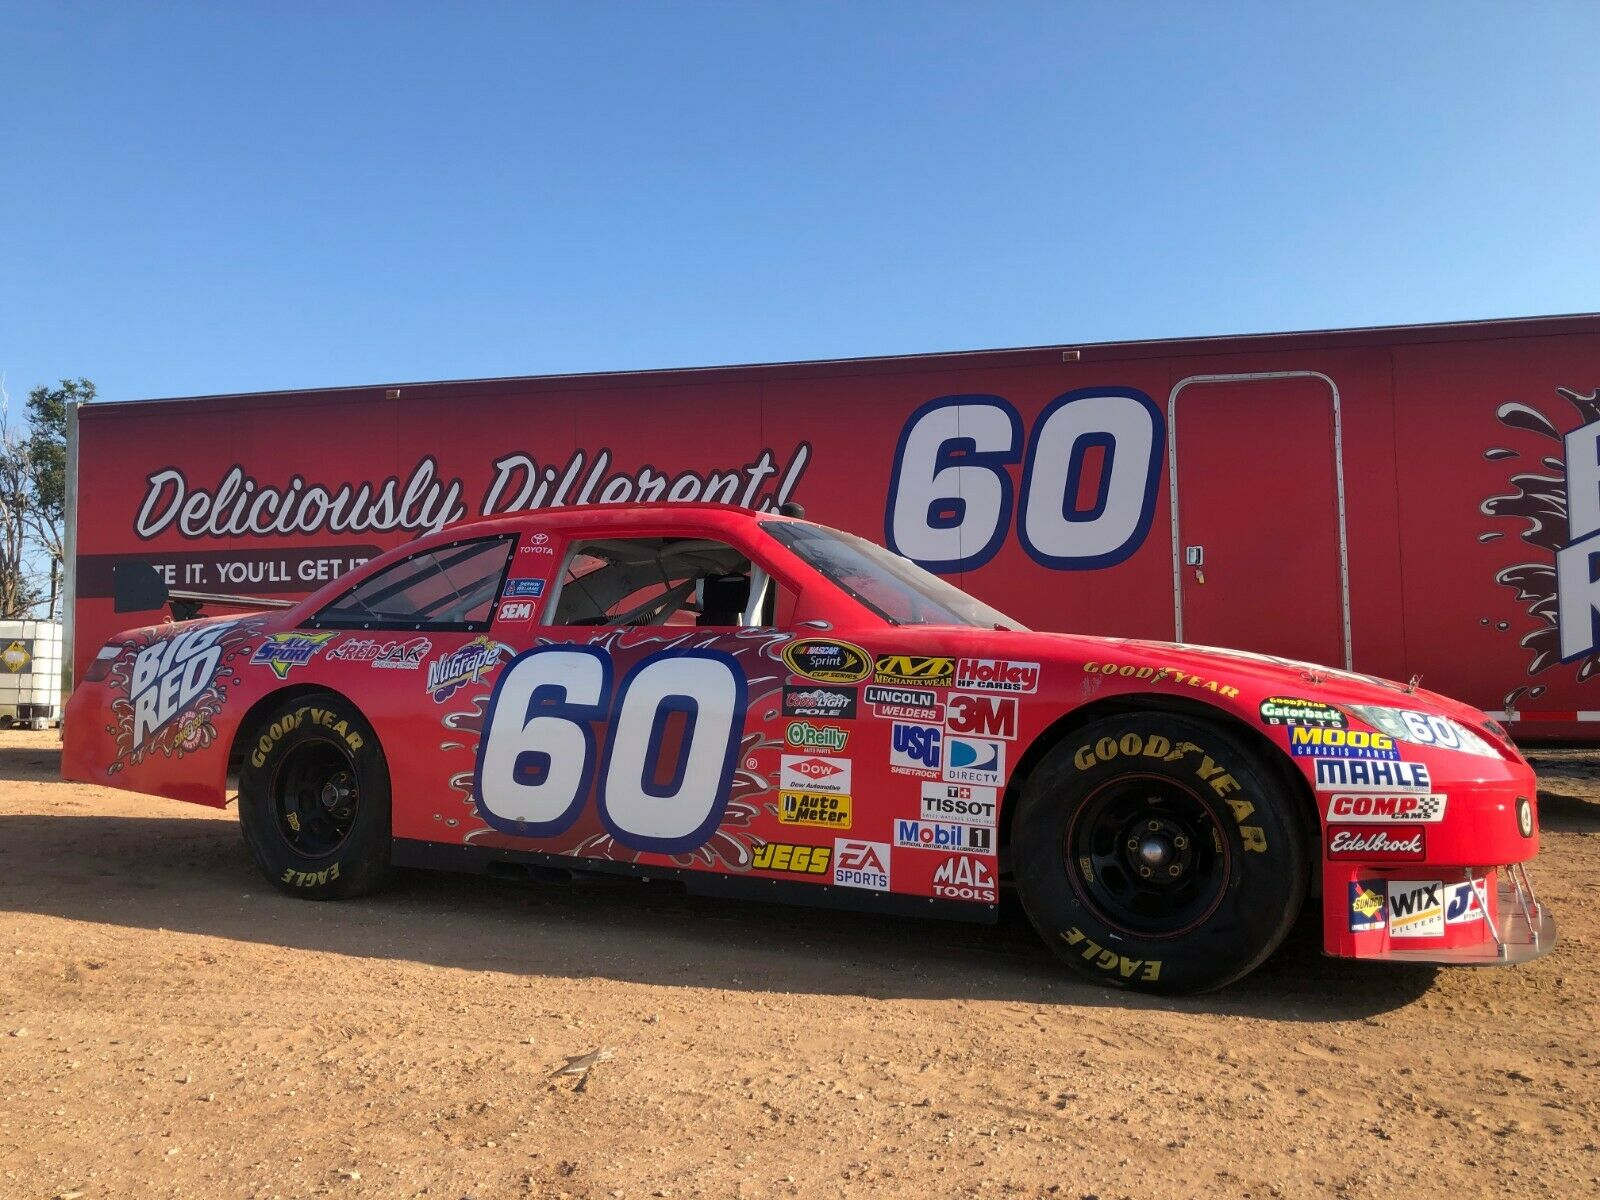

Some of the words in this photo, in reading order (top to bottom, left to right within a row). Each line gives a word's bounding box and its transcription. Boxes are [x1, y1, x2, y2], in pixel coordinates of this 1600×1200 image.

[887, 389, 1162, 570] 60
[136, 456, 465, 537] Deliciously
[520, 546, 554, 555] TOYOTA
[185, 564, 207, 584] IT.
[216, 561, 291, 583] YOU'LL
[298, 559, 343, 581] GET
[500, 604, 531, 619] SEM
[253, 643, 319, 662] SPORT
[806, 646, 840, 655] NASCAR
[130, 621, 240, 701] BIG
[810, 656, 841, 667] Sprint
[874, 674, 922, 686] MECHANIX
[924, 677, 952, 687] WEAR
[958, 659, 1037, 691] Holley
[958, 680, 975, 689] HP
[977, 680, 1021, 691] CARBS
[133, 645, 222, 749] RED
[786, 692, 817, 707] Coors
[817, 698, 851, 707] LIGHT
[869, 689, 931, 706] LINCOLN
[795, 708, 841, 716] POLE
[881, 706, 936, 719] WELDERS
[947, 695, 1016, 737] 3M
[1261, 703, 1341, 720] Gatorback
[1269, 718, 1342, 728] BELTS
[1400, 711, 1460, 748] 60
[251, 706, 365, 768] GOODYEAR
[788, 723, 846, 749] O'Reilly
[1292, 727, 1393, 750] MOOG
[475, 645, 746, 851] 60
[893, 724, 940, 768] USG
[1297, 746, 1349, 757] CHASSIS
[1359, 748, 1394, 759] PARTS
[890, 766, 938, 779] SHEETROCK
[950, 770, 998, 783] DIRECTV
[1316, 760, 1429, 787] MAHLE
[806, 783, 840, 791] Automotive
[1073, 732, 1267, 853] GOODYEAR
[800, 795, 838, 809] Auto
[923, 798, 995, 816] TISSOT
[1333, 798, 1418, 815] COMP
[796, 807, 847, 822] Meter
[900, 821, 961, 846] Mobil
[1330, 832, 1422, 852] Edelbrock
[752, 843, 832, 874] JEGS
[838, 844, 885, 873] EA
[281, 861, 340, 887] EAGLE
[836, 870, 887, 887] SPORTS
[933, 856, 994, 888] MAC
[933, 885, 995, 901] TOOLS
[1390, 883, 1440, 917] WIX
[1354, 895, 1384, 911] SUNOCO
[1391, 916, 1441, 935] FILTERS
[1060, 926, 1163, 981] EAGLE
